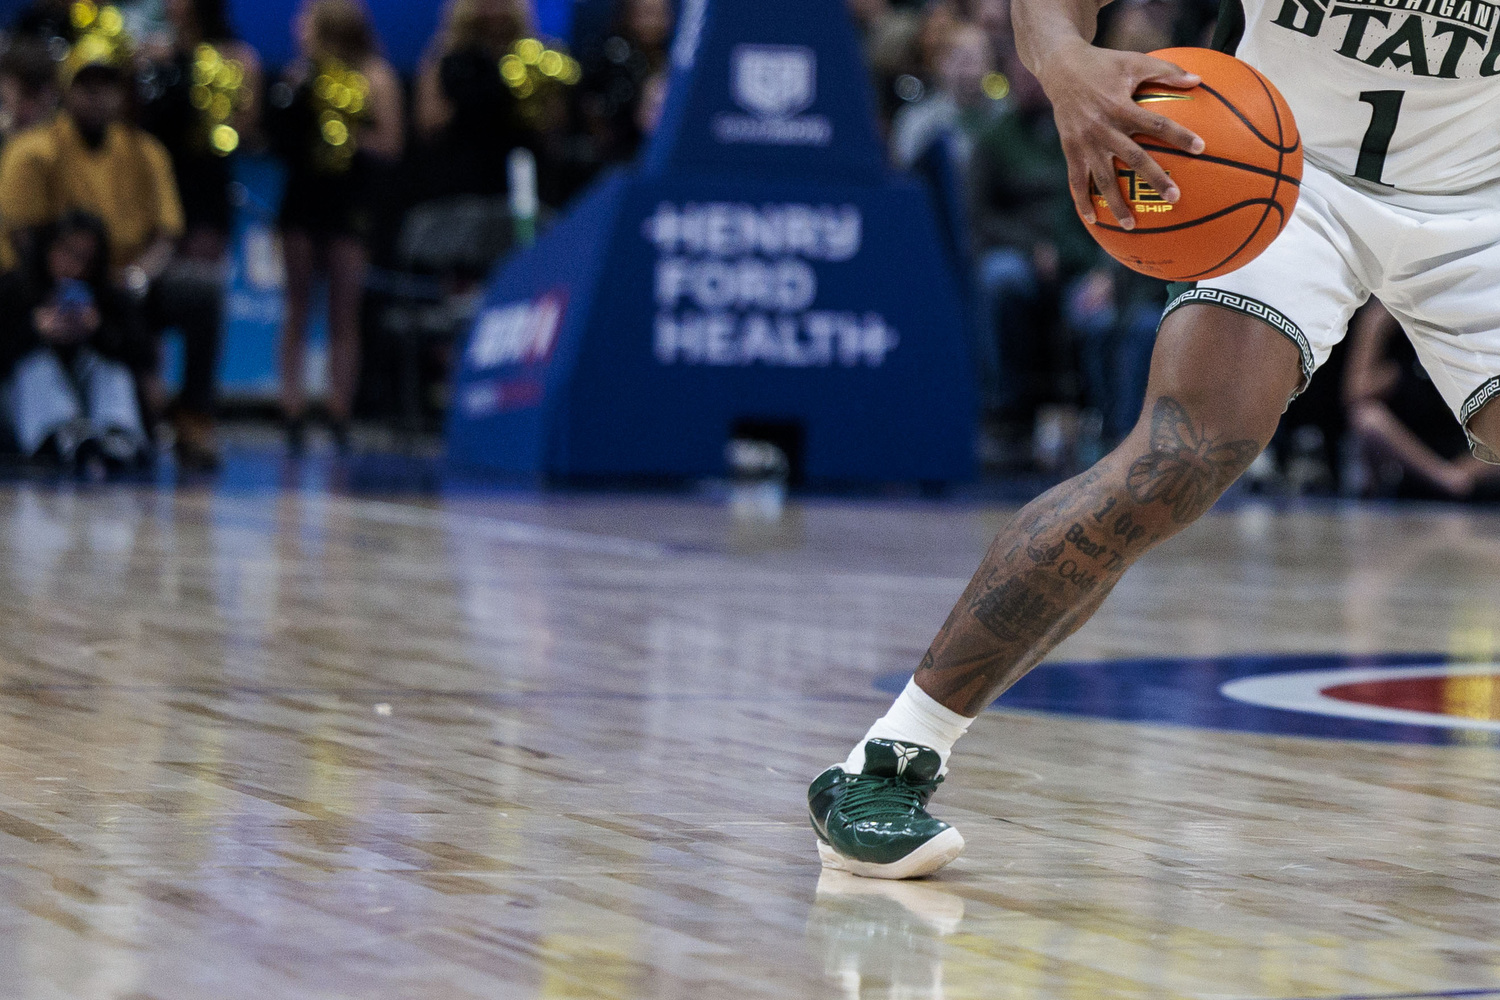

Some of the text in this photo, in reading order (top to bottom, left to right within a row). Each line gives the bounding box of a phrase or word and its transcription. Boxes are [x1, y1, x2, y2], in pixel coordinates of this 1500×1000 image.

[1354, 89, 1406, 188] 1
[645, 203, 862, 262] HENRY
[653, 258, 818, 311] FORD
